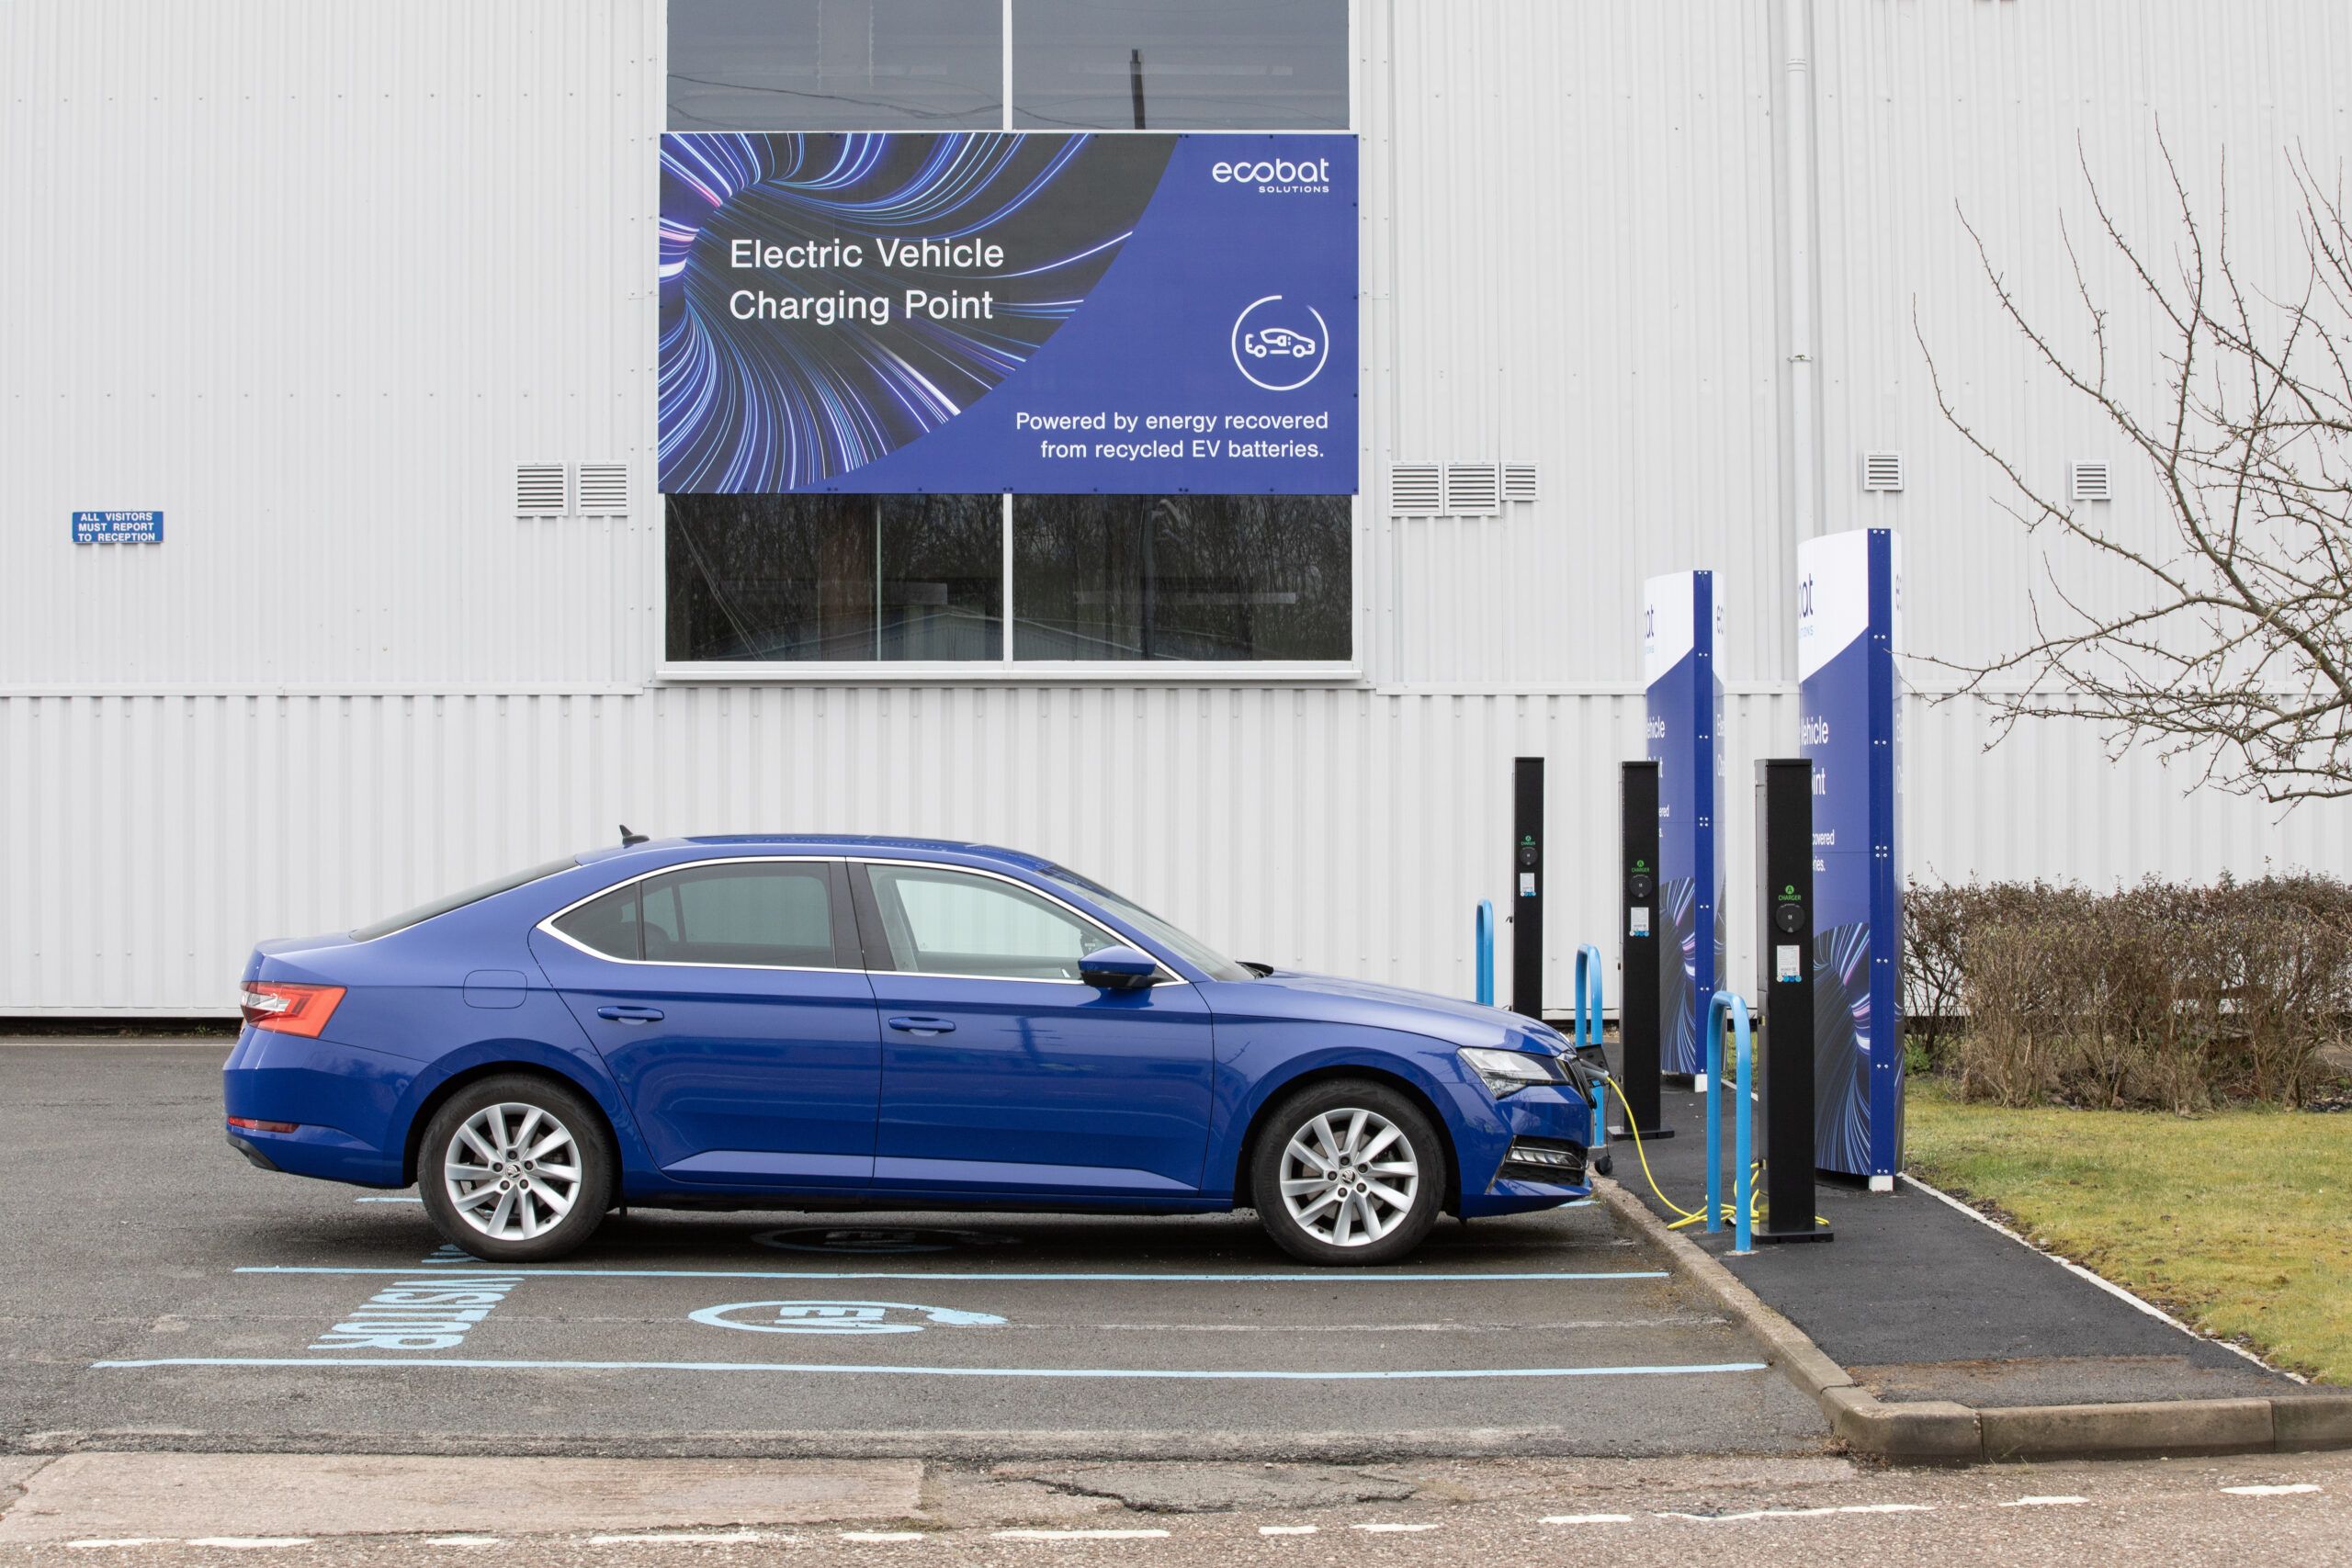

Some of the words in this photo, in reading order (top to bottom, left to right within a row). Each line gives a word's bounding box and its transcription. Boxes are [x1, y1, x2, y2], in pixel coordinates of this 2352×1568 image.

[1211, 157, 1330, 184] ecobat
[1258, 185, 1329, 194] SOLUTIONS
[729, 237, 863, 269] Electric
[876, 237, 1004, 269] Vehicle
[729, 288, 889, 326] Charging
[905, 289, 993, 320] Point
[1016, 412, 1106, 431] Powered
[1114, 412, 1139, 435] by
[1145, 414, 1218, 435] energy
[1225, 411, 1329, 431] recovered
[1040, 439, 1087, 459] from
[1095, 439, 1184, 463] recycled
[1192, 439, 1221, 459] EV
[1228, 439, 1324, 459] batteries.
[78, 523, 107, 532] MUST
[112, 523, 154, 532] REPORT
[81, 513, 99, 522] ALL
[105, 512, 153, 522] VISITORS
[78, 533, 92, 542] TO
[97, 533, 155, 542] RECEPTION
[1647, 716, 1666, 739] ehicle
[1812, 767, 1826, 795] int
[307, 1277, 526, 1350] VISITOR
